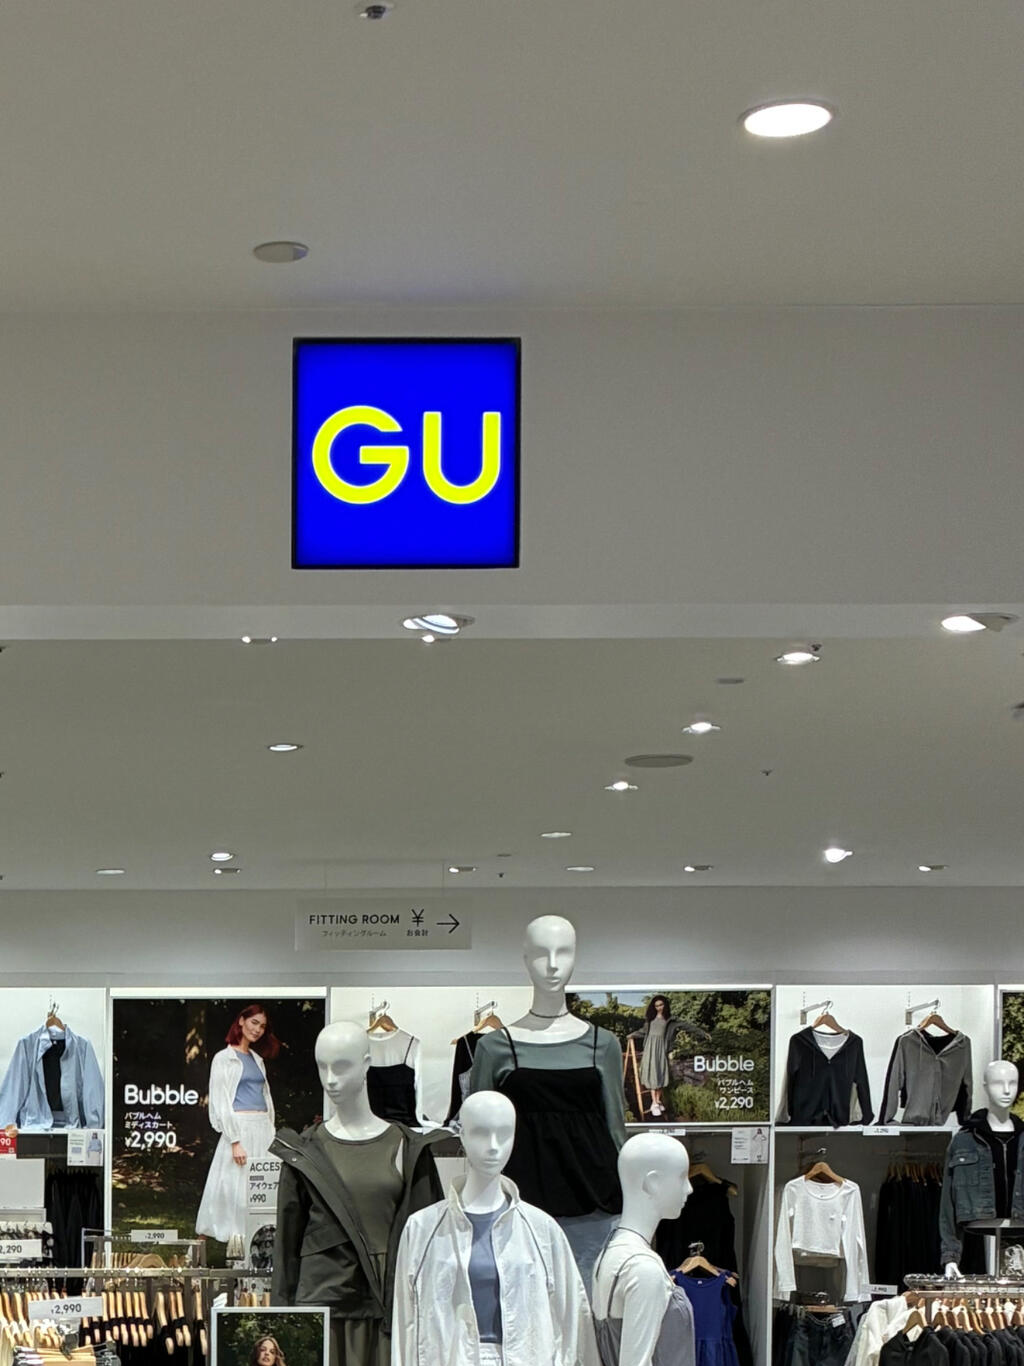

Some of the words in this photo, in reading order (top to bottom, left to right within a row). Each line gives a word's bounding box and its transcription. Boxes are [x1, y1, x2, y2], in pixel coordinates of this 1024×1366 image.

[312, 405, 502, 505] GU
[309, 914, 358, 925] FITTING
[362, 914, 400, 925] ROOM
[694, 1055, 755, 1072] Bubble
[717, 1079, 754, 1087] バブルヘム
[124, 1083, 200, 1105] Bubble
[719, 1087, 754, 1095] ワンピース
[715, 1096, 754, 1110] ¥2,290
[124, 1111, 162, 1121] バブルヘム
[124, 1121, 174, 1130] ミディスカート
[124, 1131, 177, 1150] ¥2,990
[51, 1303, 82, 1315] ¥2,990
